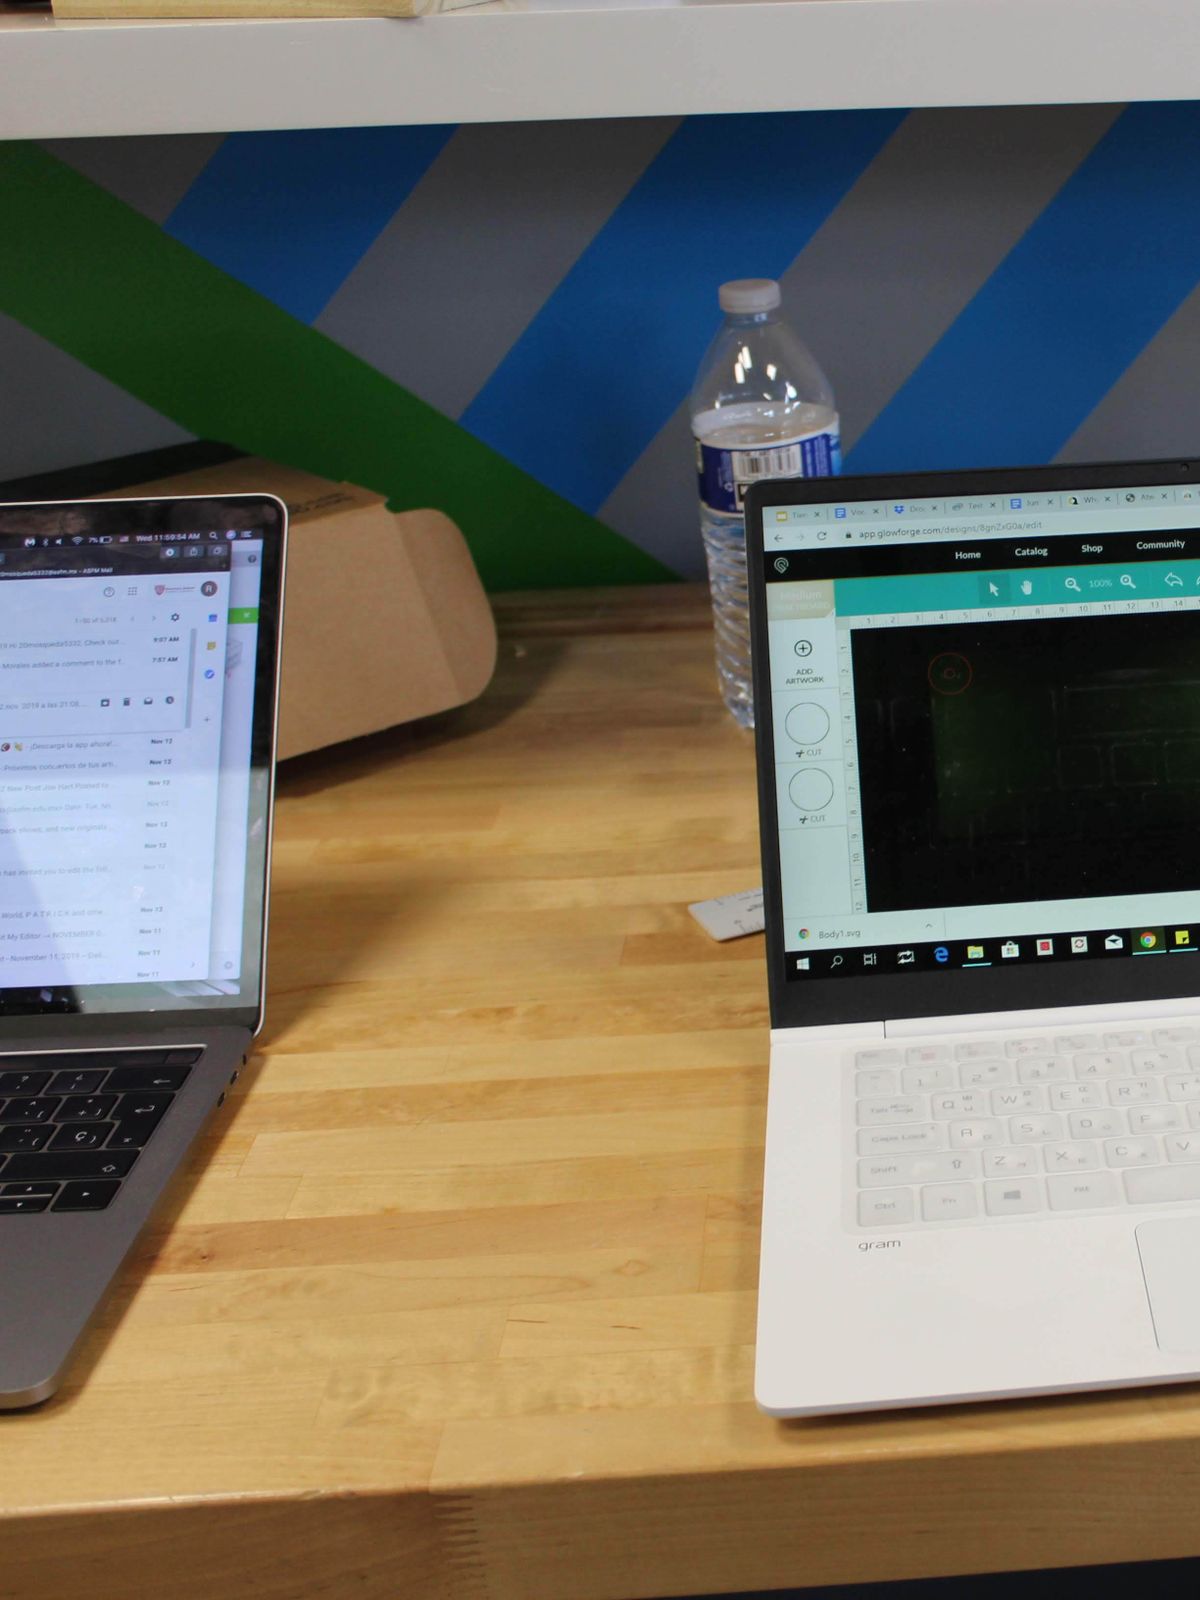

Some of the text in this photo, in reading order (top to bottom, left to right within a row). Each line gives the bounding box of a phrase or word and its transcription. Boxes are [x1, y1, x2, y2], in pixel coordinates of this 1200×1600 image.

[1081, 544, 1103, 554] Shop
[1136, 540, 1185, 550] Community
[955, 551, 981, 560] Home
[1015, 547, 1048, 557] Catalog
[1089, 579, 1112, 588] 100%
[61, 660, 94, 668] comment
[796, 668, 813, 676] ADD
[785, 676, 824, 685] ARTWORK
[819, 930, 861, 940] Body1.svg
[858, 1240, 901, 1252] gram
